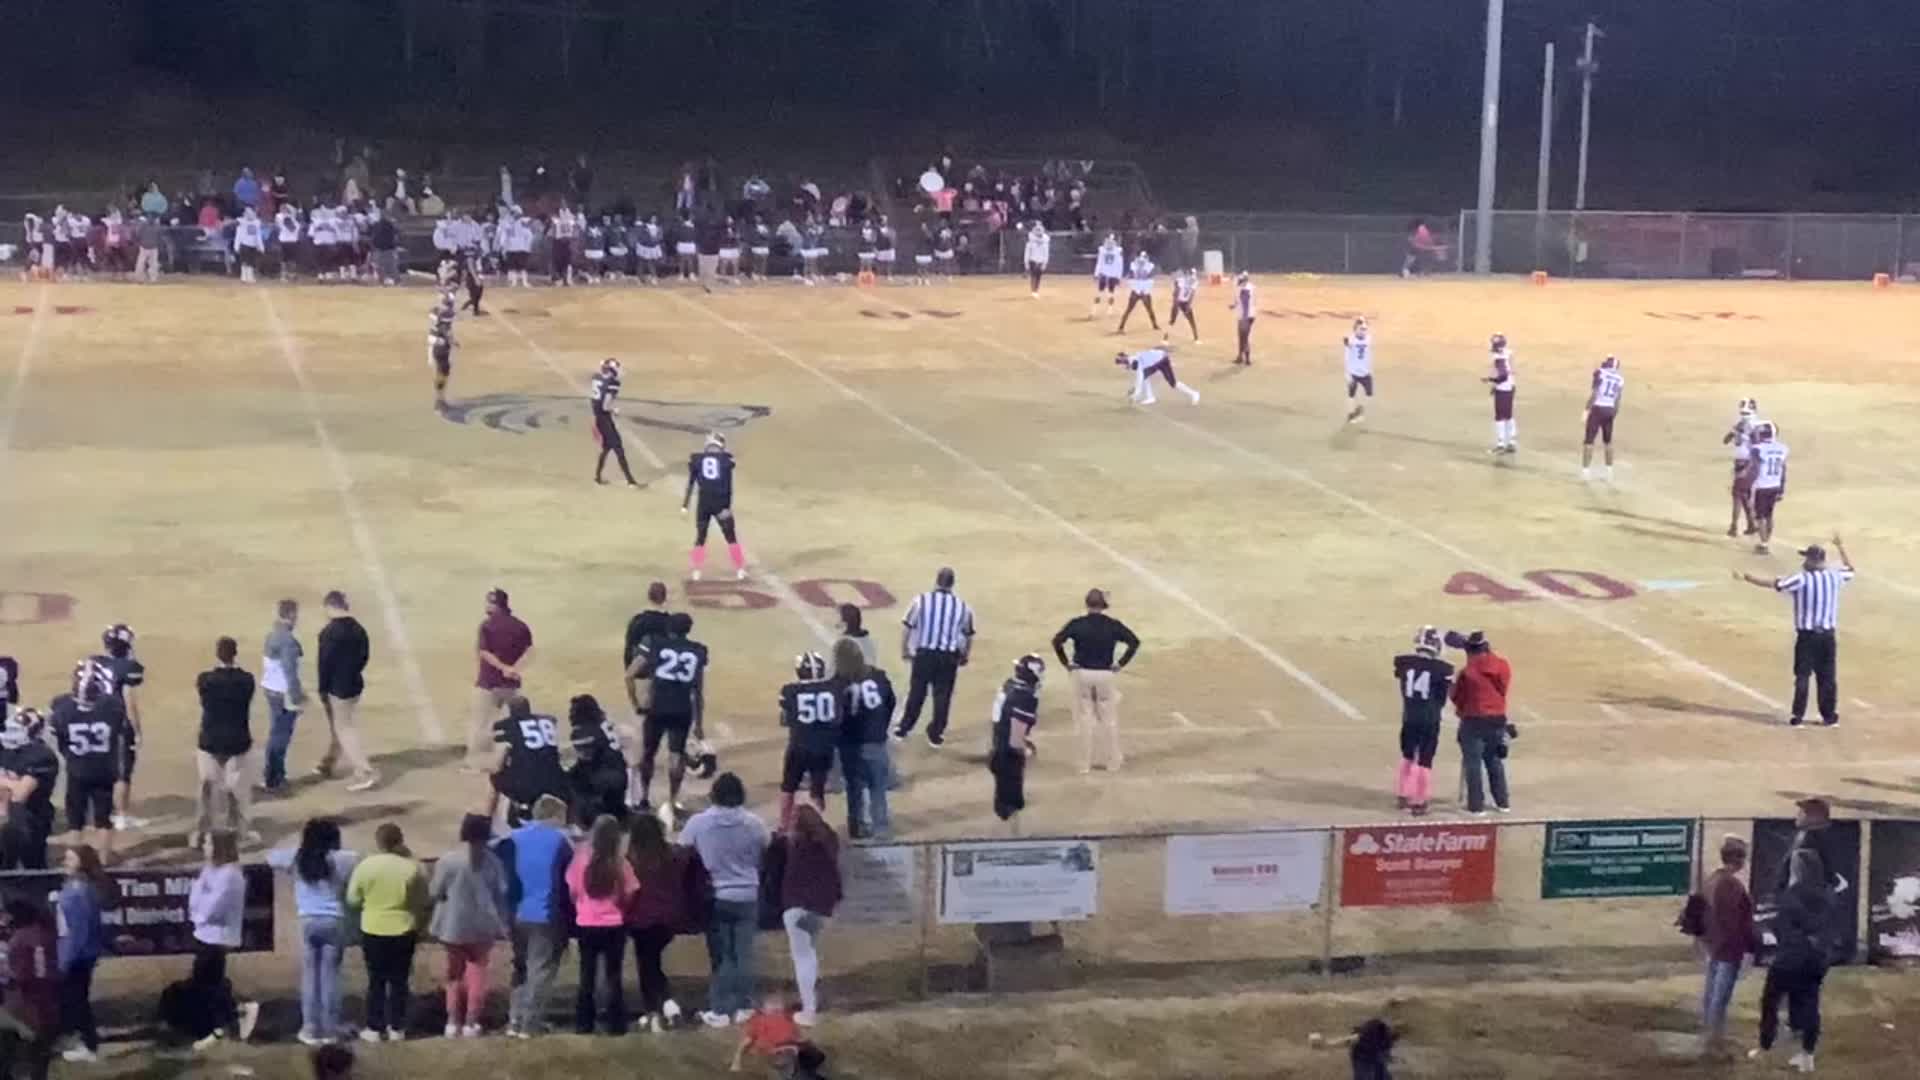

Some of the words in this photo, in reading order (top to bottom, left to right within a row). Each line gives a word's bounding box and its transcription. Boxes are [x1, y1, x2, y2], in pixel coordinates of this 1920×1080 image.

[702, 457, 719, 479] 8
[656, 648, 698, 682] 23
[1406, 669, 1430, 699] 14
[797, 691, 835, 723] 50
[68, 721, 111, 755] 53
[116, 878, 159, 897] Tim
